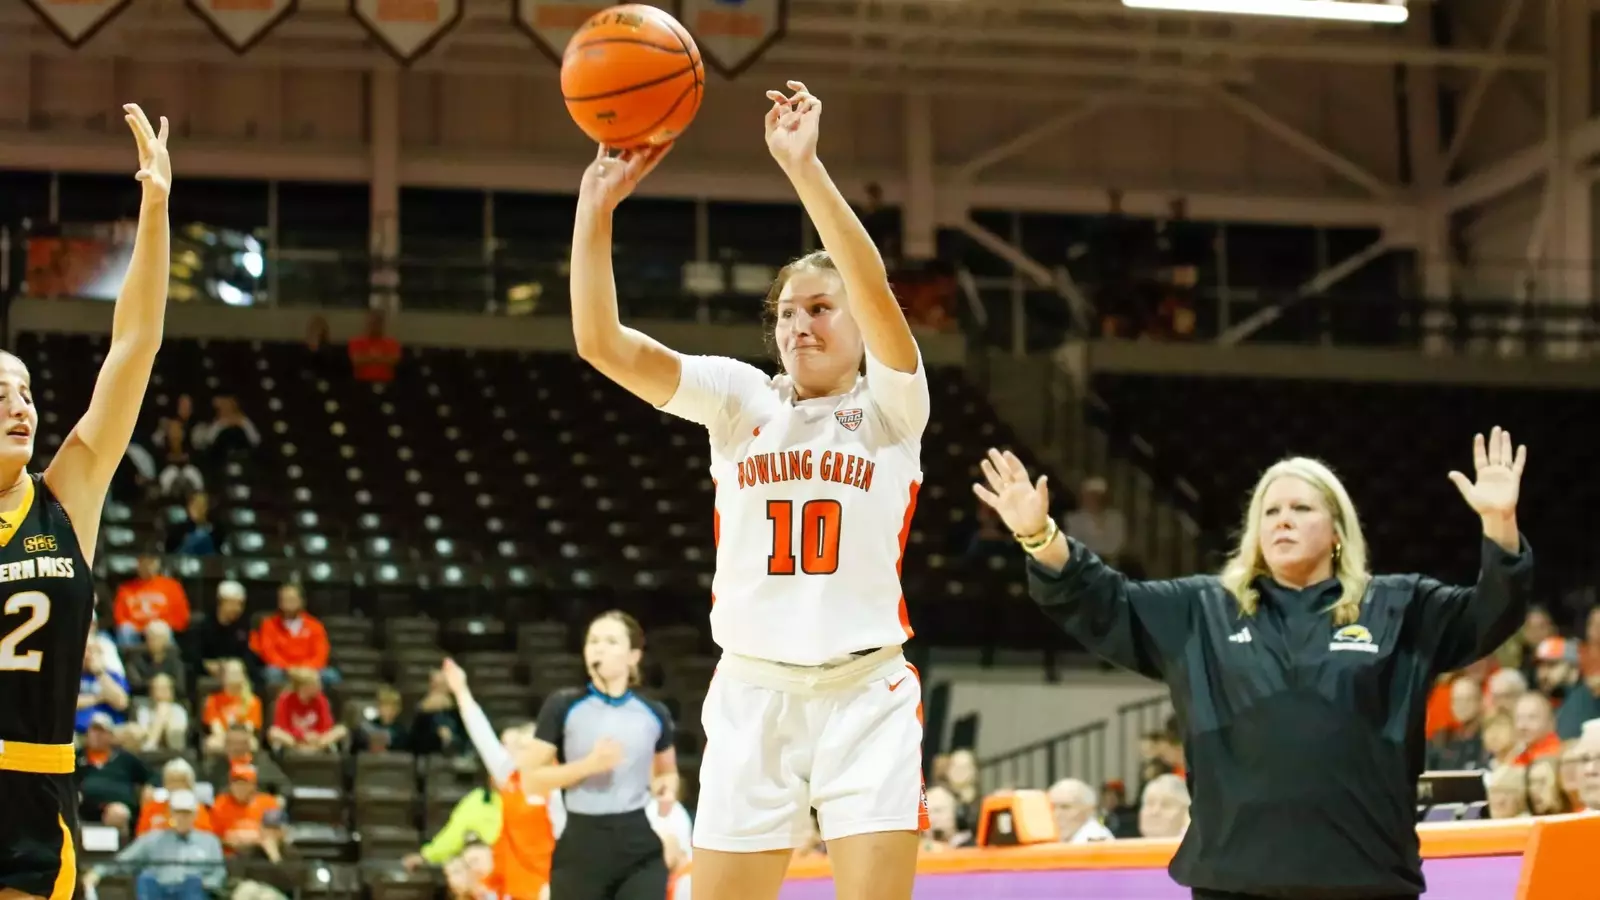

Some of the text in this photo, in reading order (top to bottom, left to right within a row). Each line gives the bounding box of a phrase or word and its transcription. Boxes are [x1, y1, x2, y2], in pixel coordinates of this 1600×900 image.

[820, 450, 875, 492] GREEN
[24, 534, 58, 553] SBC
[766, 499, 842, 576] 10
[36, 556, 75, 579] MISS
